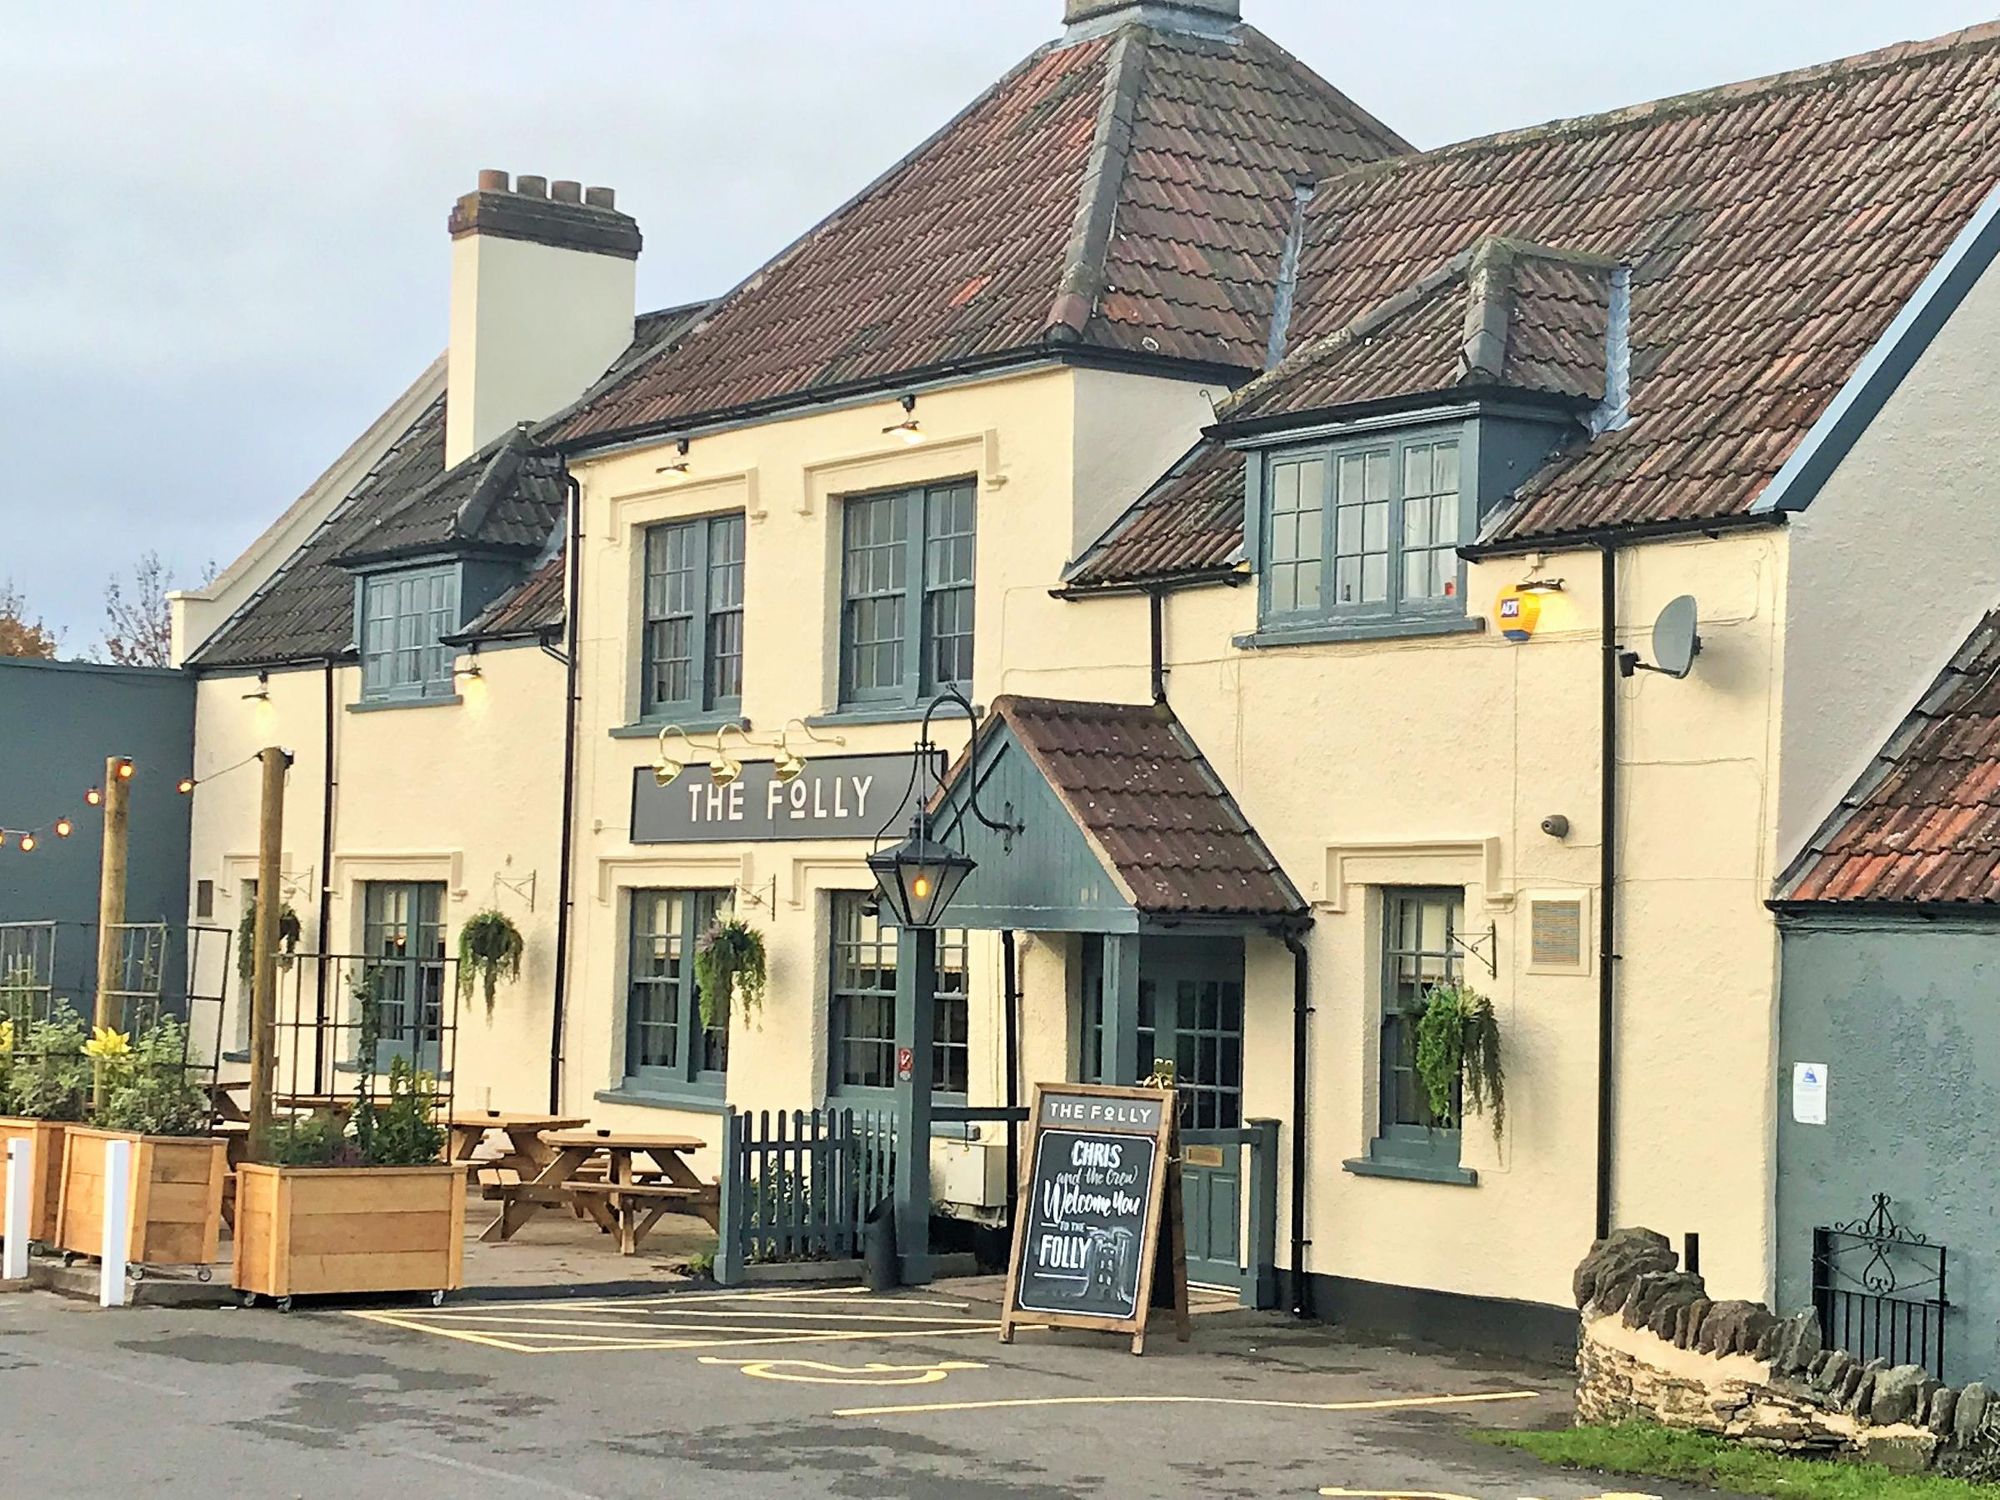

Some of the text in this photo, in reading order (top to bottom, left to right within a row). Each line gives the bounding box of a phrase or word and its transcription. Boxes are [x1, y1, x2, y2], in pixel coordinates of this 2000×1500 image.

[688, 775, 873, 822] THE FOLLY
[1050, 1102, 1152, 1124] THE FOLLY
[1071, 1139, 1123, 1169] CHRIS
[1056, 1167, 1083, 1185] and
[1085, 1166, 1105, 1186] the
[1043, 1179, 1141, 1224] Welcome You
[1038, 1234, 1093, 1270] FOLLY
